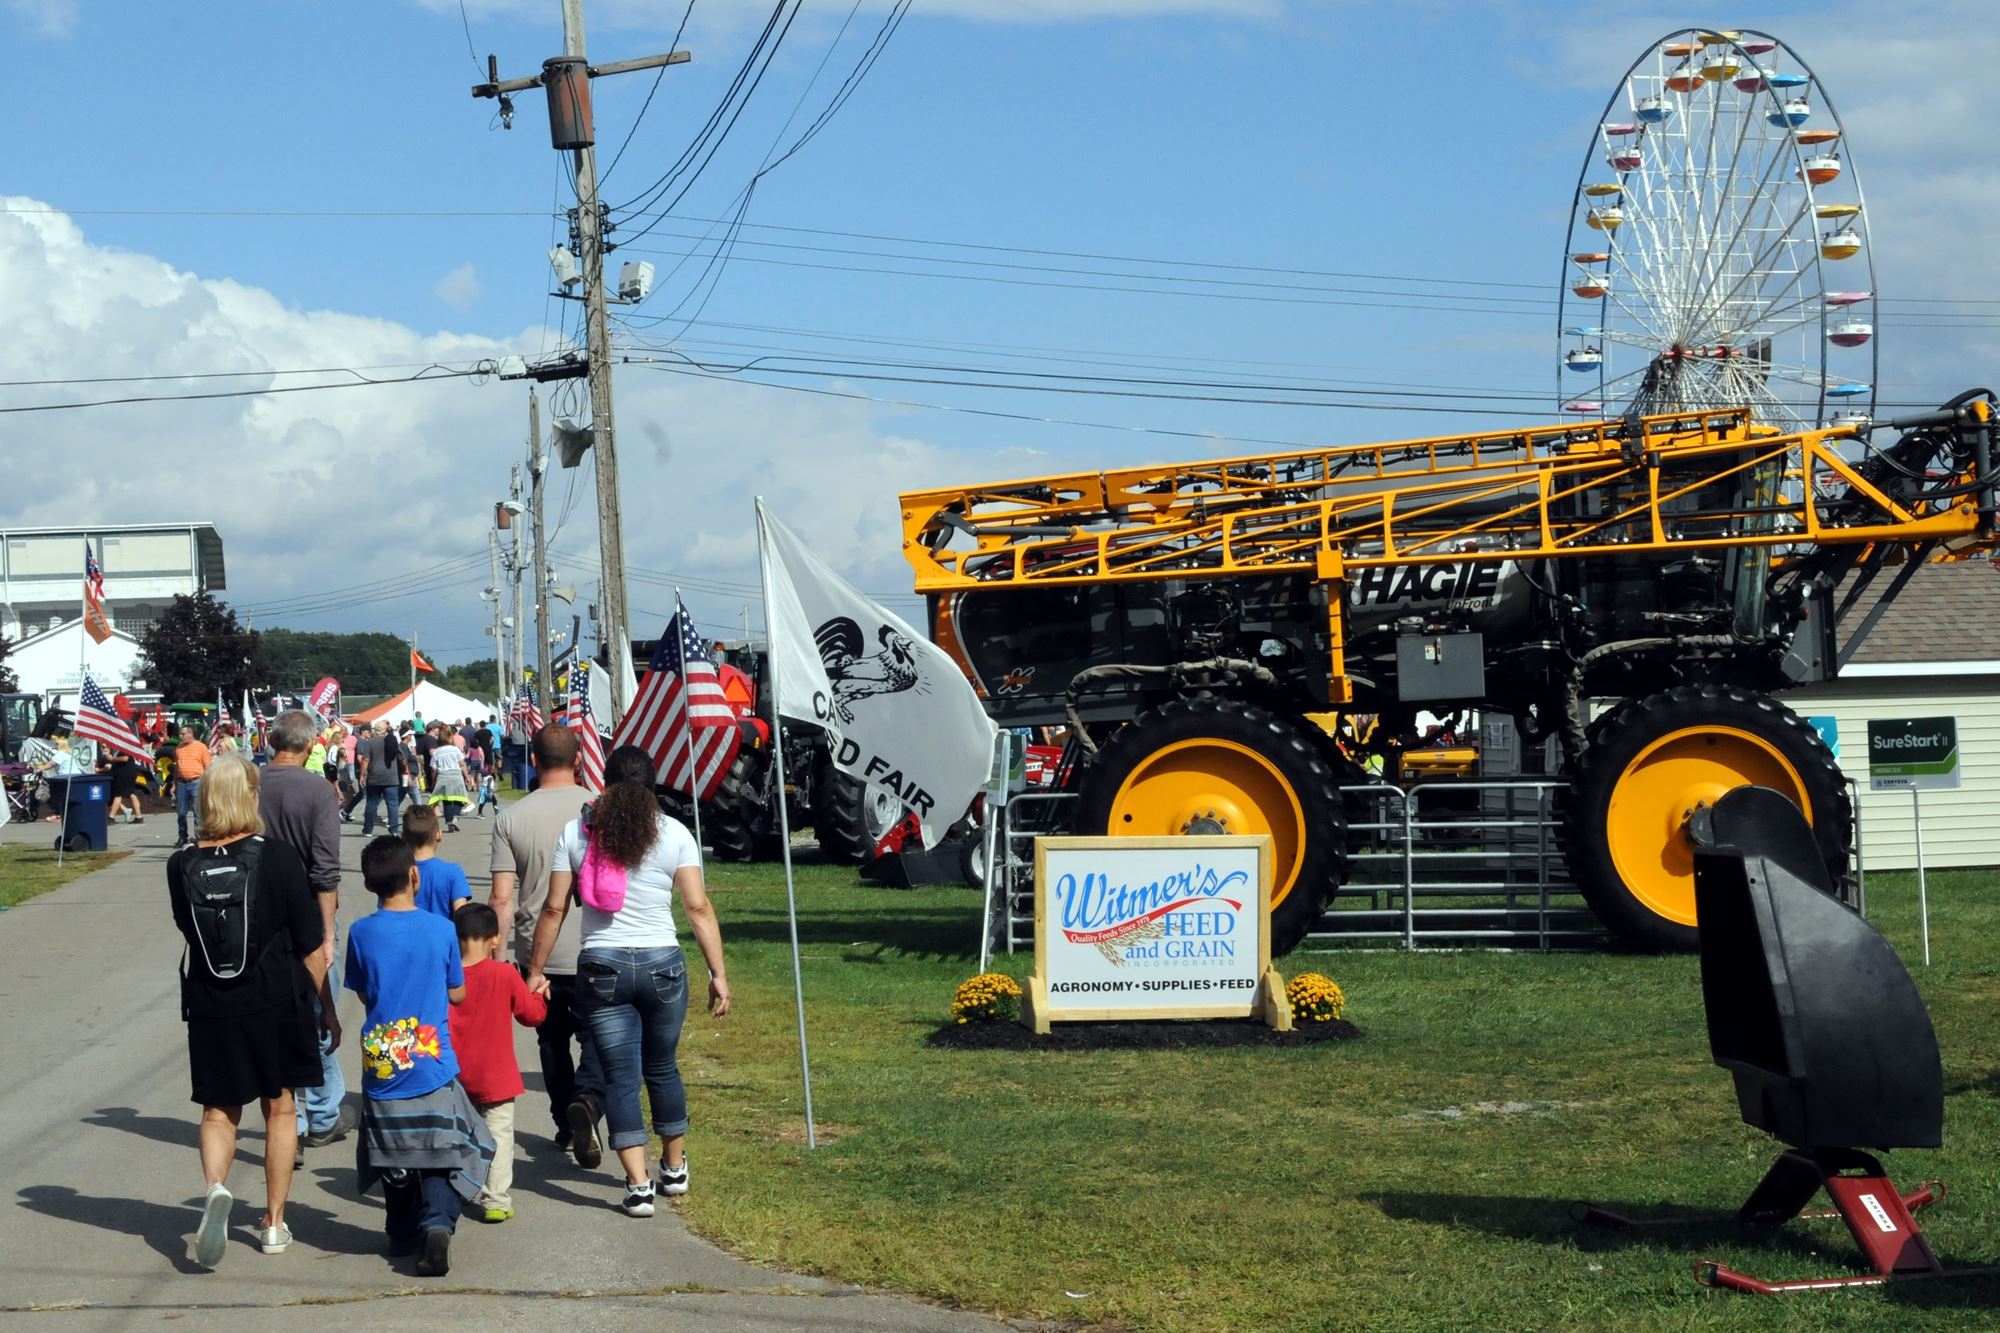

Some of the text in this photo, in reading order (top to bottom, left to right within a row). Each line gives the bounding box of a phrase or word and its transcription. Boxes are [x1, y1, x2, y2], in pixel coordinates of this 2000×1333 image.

[1359, 562, 1501, 605] HAGIE
[864, 755, 935, 819] FAIR
[1056, 863, 1248, 928] Witmer's
[1071, 933, 1098, 943] Quality
[1098, 929, 1118, 940] Feeds
[1118, 922, 1136, 934] Since
[1164, 912, 1235, 936] FEED
[1125, 940, 1235, 959] and GRAIN
[1127, 959, 1234, 967] INCORPORATED
[1050, 979, 1255, 993] AGRONOMY SUPPLIES FEED
